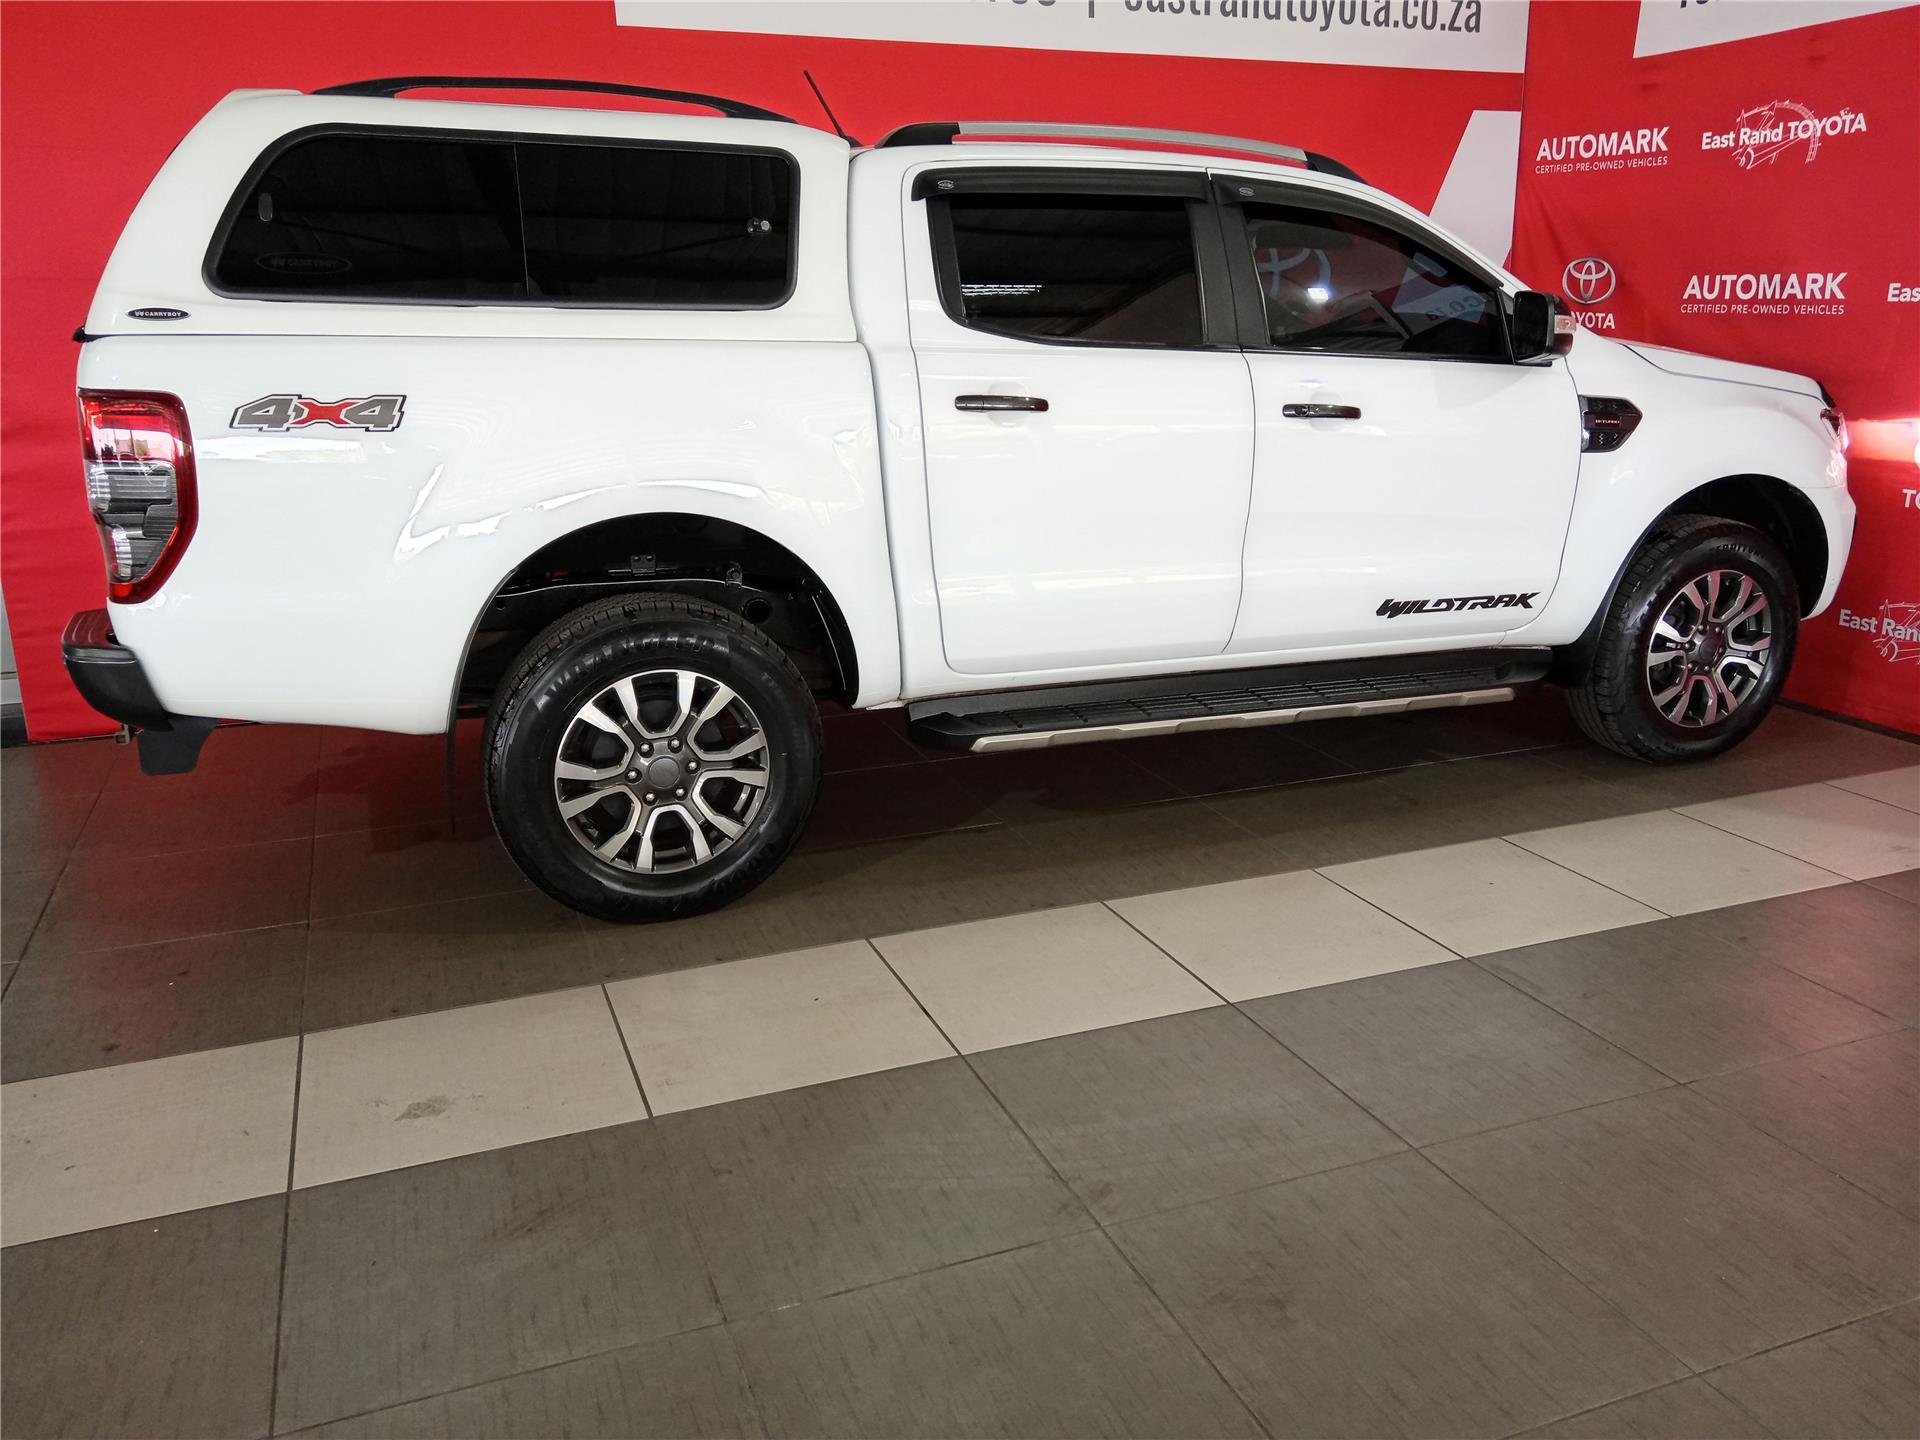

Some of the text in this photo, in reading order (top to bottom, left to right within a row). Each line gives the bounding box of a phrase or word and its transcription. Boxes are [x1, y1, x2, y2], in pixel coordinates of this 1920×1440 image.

[1535, 127, 1670, 162] AUTOMARK
[1701, 112, 1867, 150] East Rand TOYOTA
[1535, 155, 1668, 175] CERTIFIED PRE-OWNED VEHICLES
[1682, 272, 1848, 301] AUTOMARK
[1570, 310, 1616, 329] YOTA
[1680, 303, 1845, 316] CERTIFIED PRE-OWNED VEHICLES
[1375, 591, 1542, 619] WILDTRAK
[1838, 608, 1920, 643] East Ran
